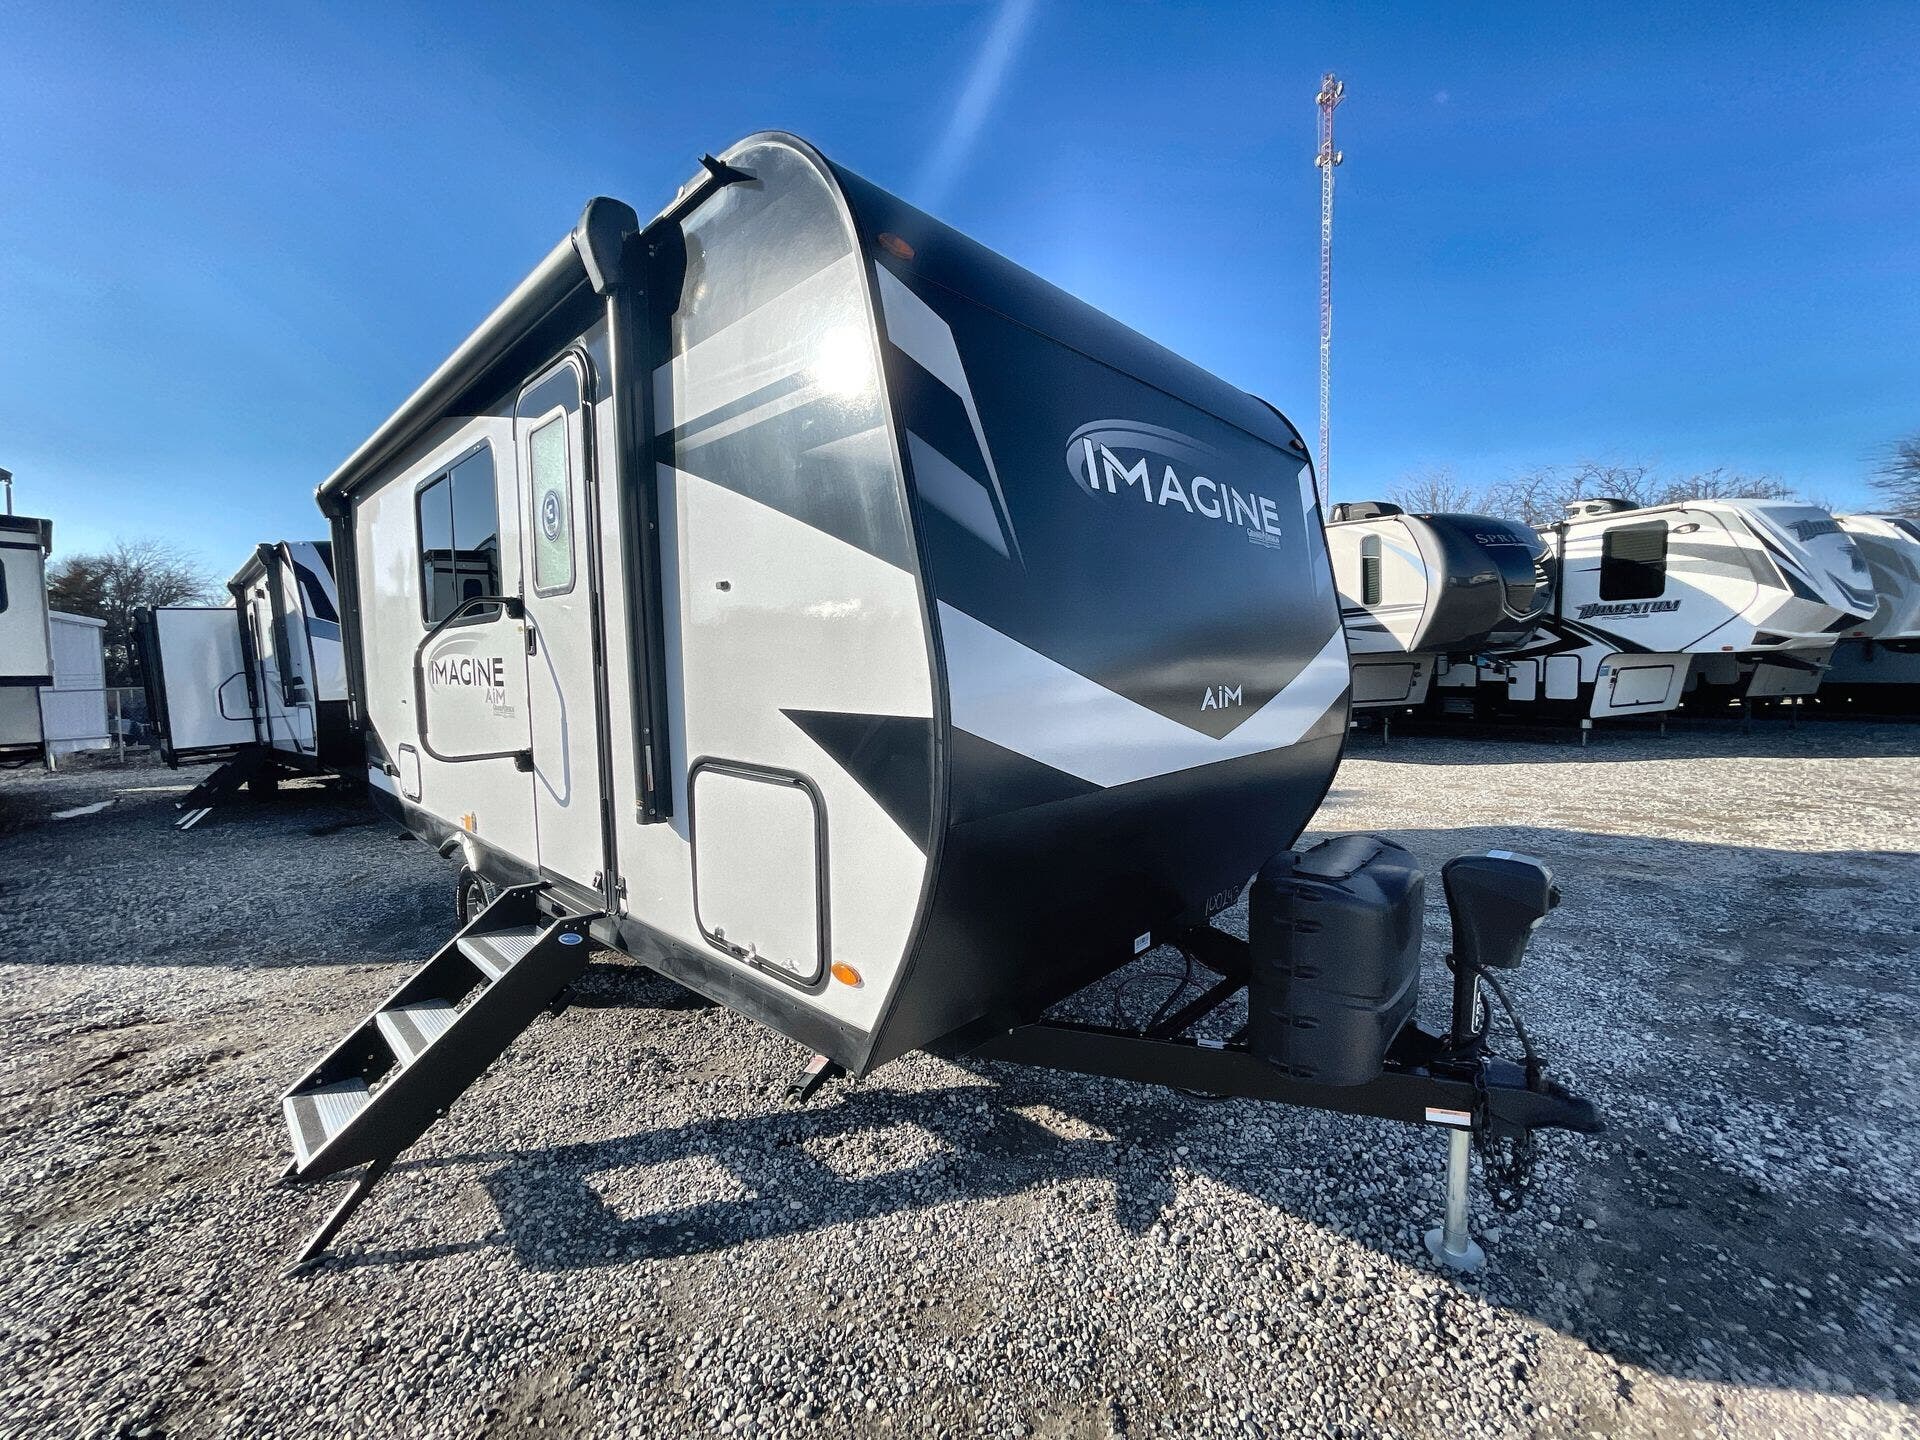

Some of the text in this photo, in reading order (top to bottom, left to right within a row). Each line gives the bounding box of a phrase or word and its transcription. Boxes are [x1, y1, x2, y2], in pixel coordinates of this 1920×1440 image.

[1082, 436, 1282, 537] IMAGINE
[1574, 599, 1682, 620] MOMENTUM
[430, 657, 505, 688] IMAGINE
